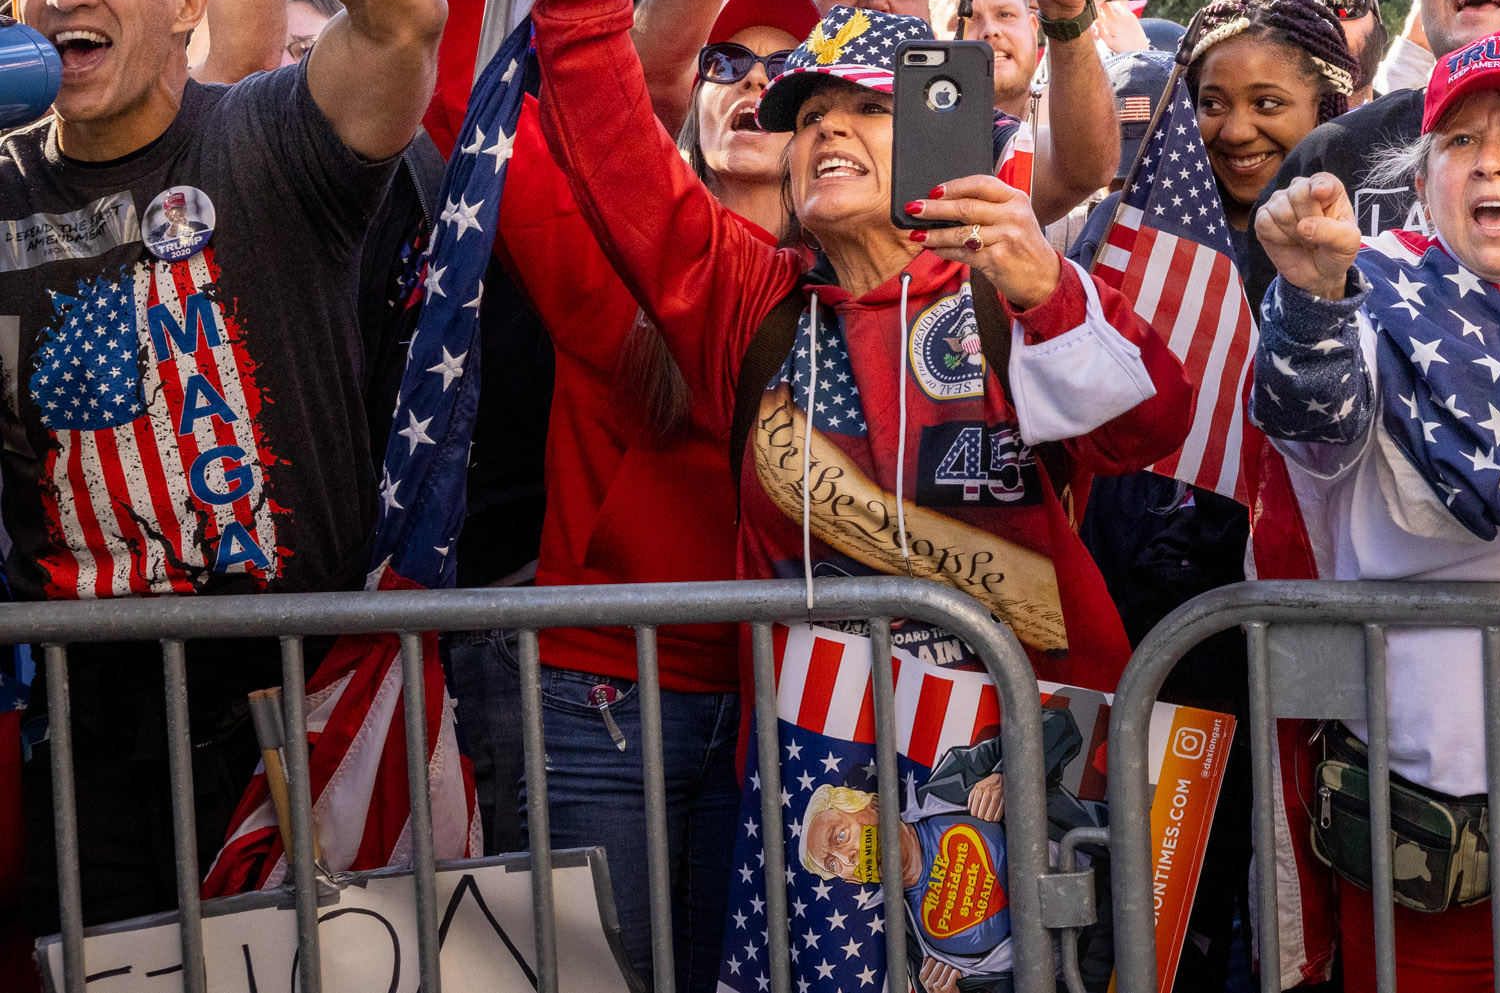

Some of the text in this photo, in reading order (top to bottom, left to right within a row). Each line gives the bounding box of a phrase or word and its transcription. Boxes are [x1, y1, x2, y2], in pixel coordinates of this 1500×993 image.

[1448, 65, 1471, 84] KEEP
[5, 223, 53, 243] DEFEND
[158, 236, 203, 254] TRUMP
[171, 248, 191, 258] 2020
[914, 297, 958, 356] PRESIDENT
[940, 382, 971, 395] SEAL
[147, 292, 271, 573] MAGA
[1201, 718, 1222, 779] @daxiongart
[924, 854, 950, 910] MAKE
[974, 873, 997, 919] AGAIN
